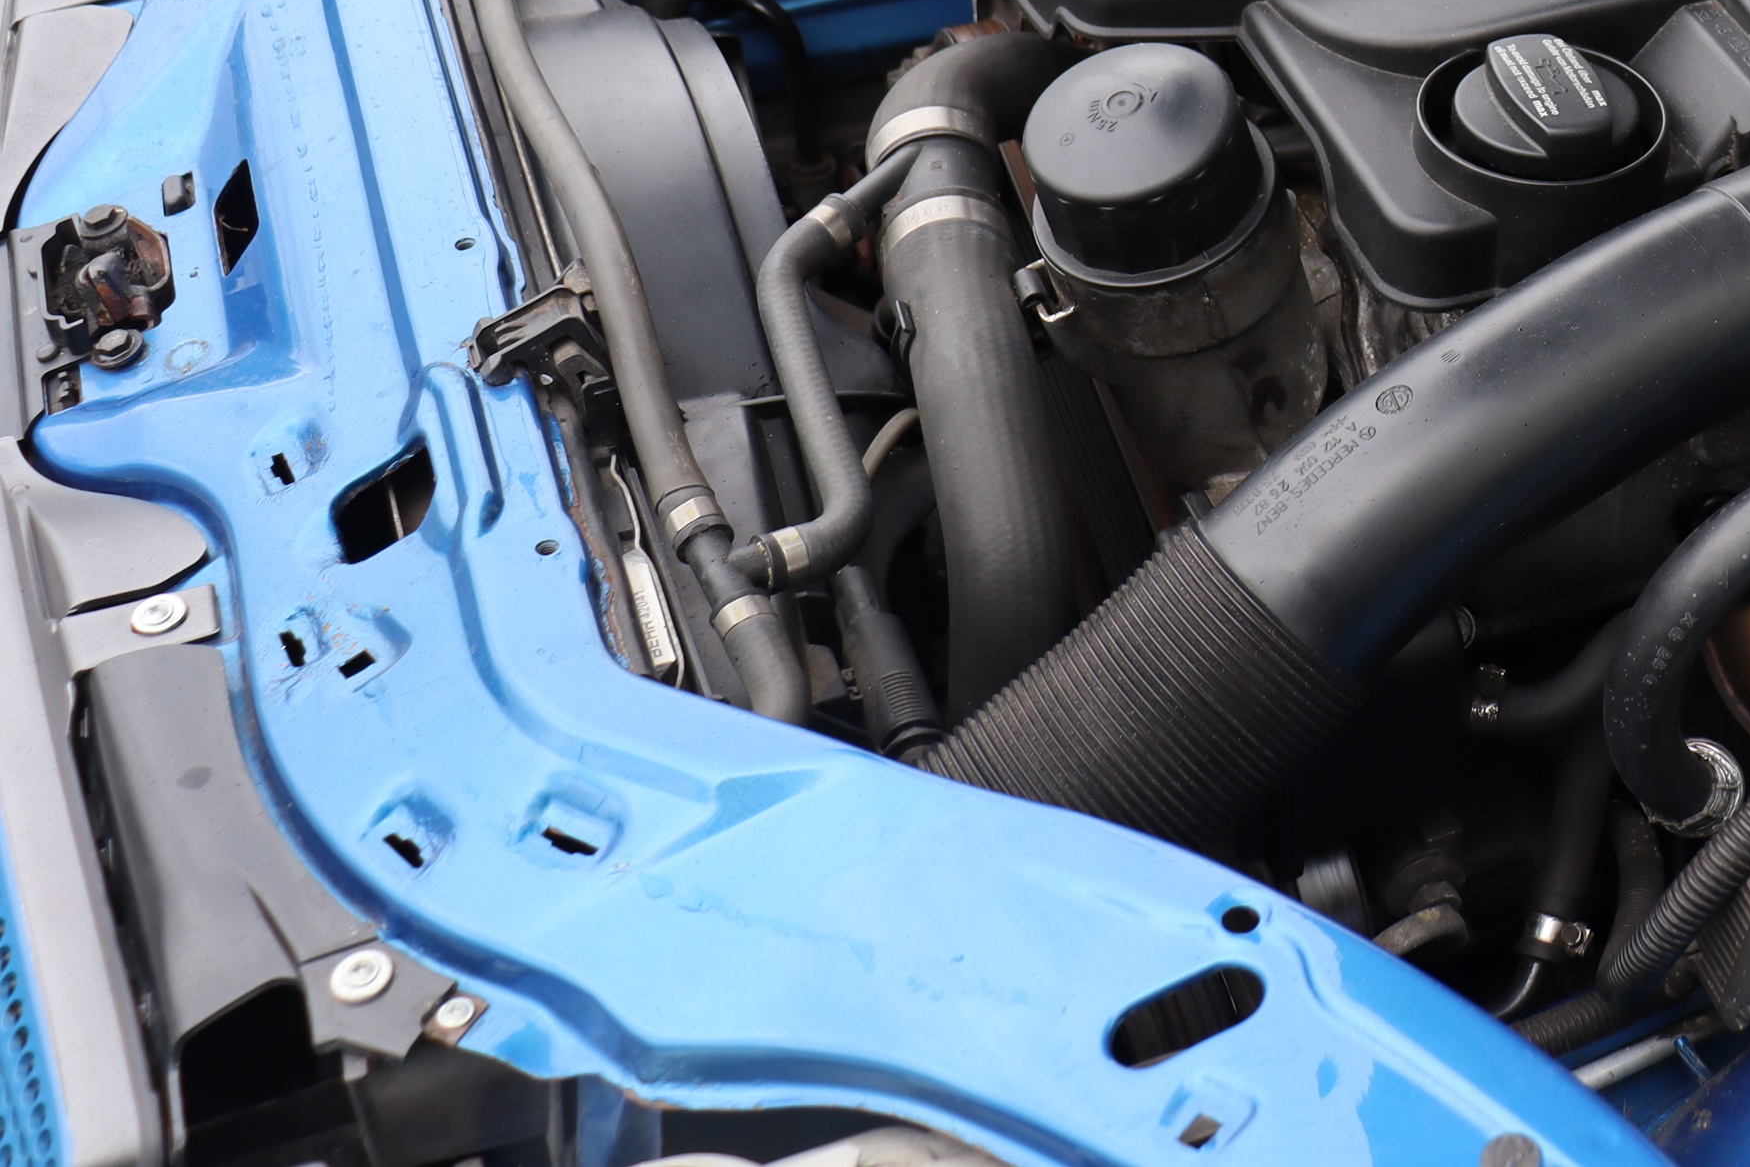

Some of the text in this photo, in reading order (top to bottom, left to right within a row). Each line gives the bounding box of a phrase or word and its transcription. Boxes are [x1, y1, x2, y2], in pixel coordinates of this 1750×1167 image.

[1541, 93, 1559, 115] engine
[1591, 89, 1607, 107] max
[1532, 100, 1548, 117] max
[1346, 421, 1357, 432] A
[1255, 438, 1359, 535] MERCEDES-BENZ
